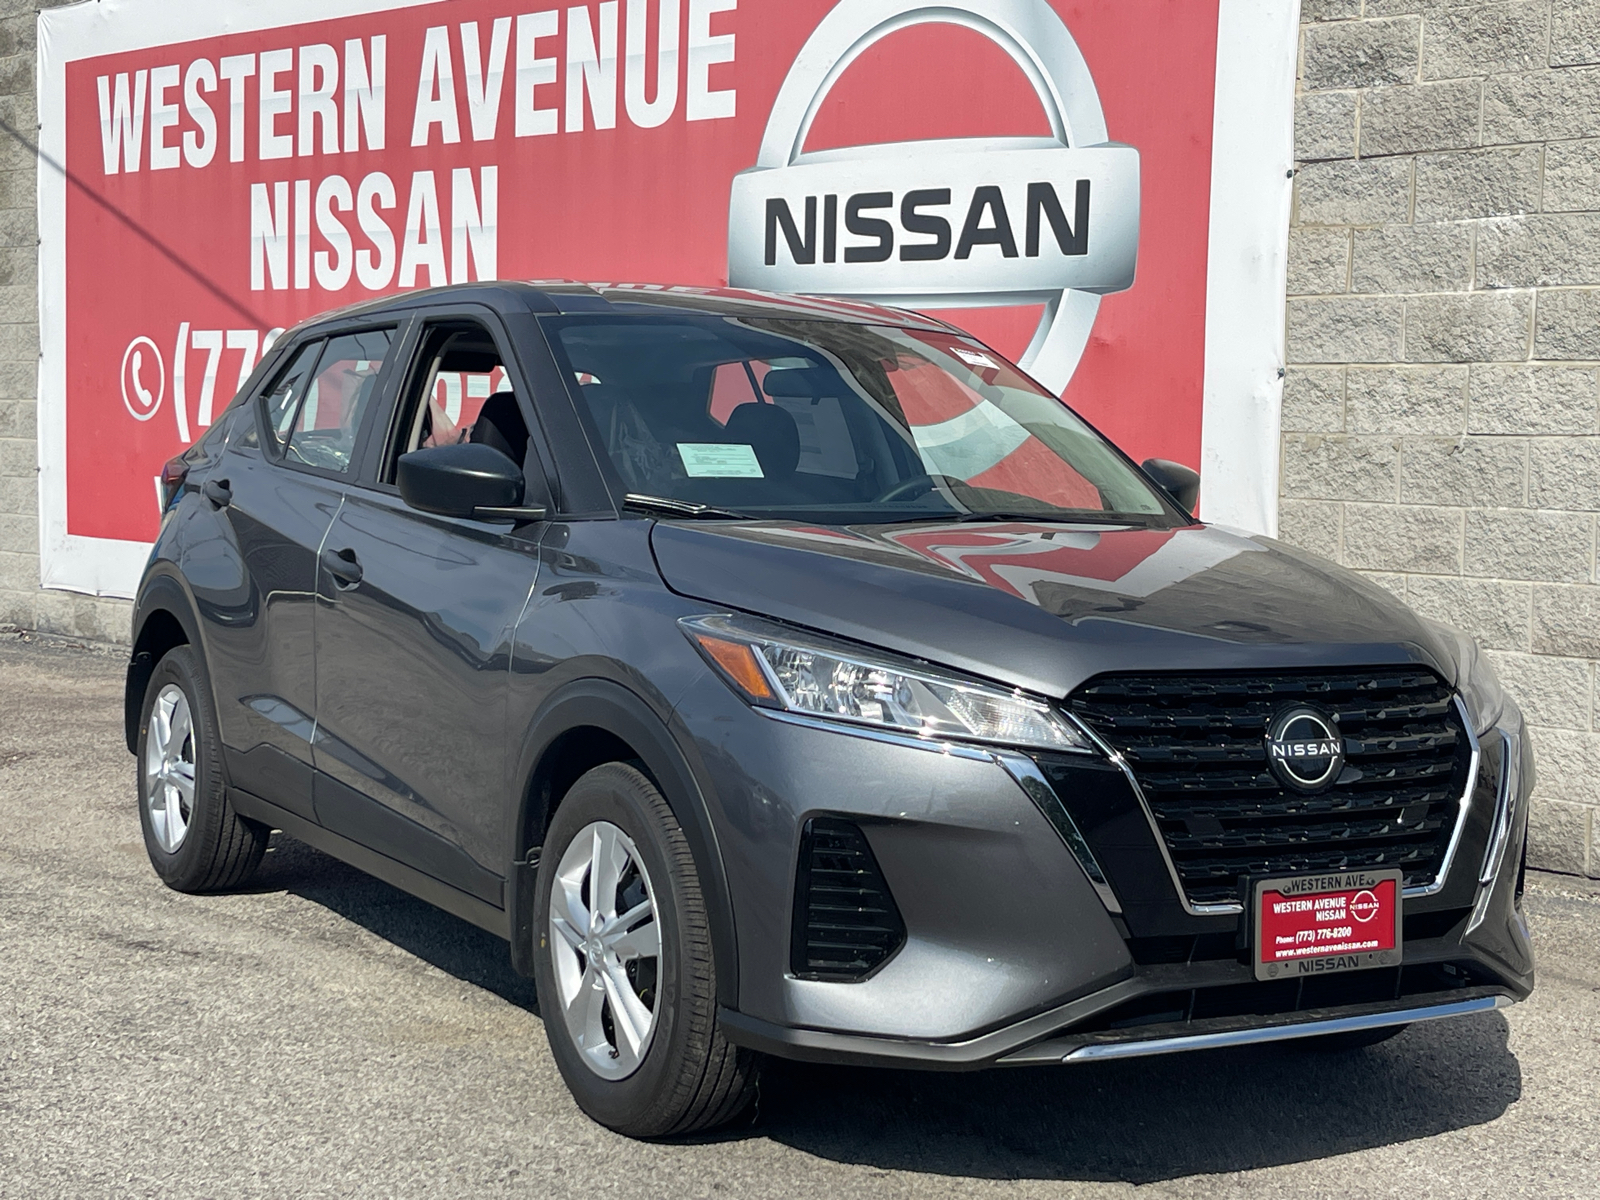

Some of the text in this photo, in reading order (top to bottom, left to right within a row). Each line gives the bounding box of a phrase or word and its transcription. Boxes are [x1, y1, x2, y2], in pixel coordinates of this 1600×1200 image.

[97, 0, 738, 174] WESTERN AVENUE
[250, 166, 498, 291] NISSAN
[764, 179, 1091, 266] NISSAN
[1272, 742, 1340, 756] NISSAN
[1291, 876, 1341, 892] WESTERN
[1273, 897, 1346, 914] WESTERN AVENUE
[1349, 902, 1379, 910] NISSAN
[1316, 909, 1346, 921] NISSAN
[1275, 936, 1294, 944] Phone:
[1296, 930, 1315, 944] (773)
[1275, 940, 1378, 957] www.westernavenissan.com
[1298, 956, 1359, 972] NISSAN
